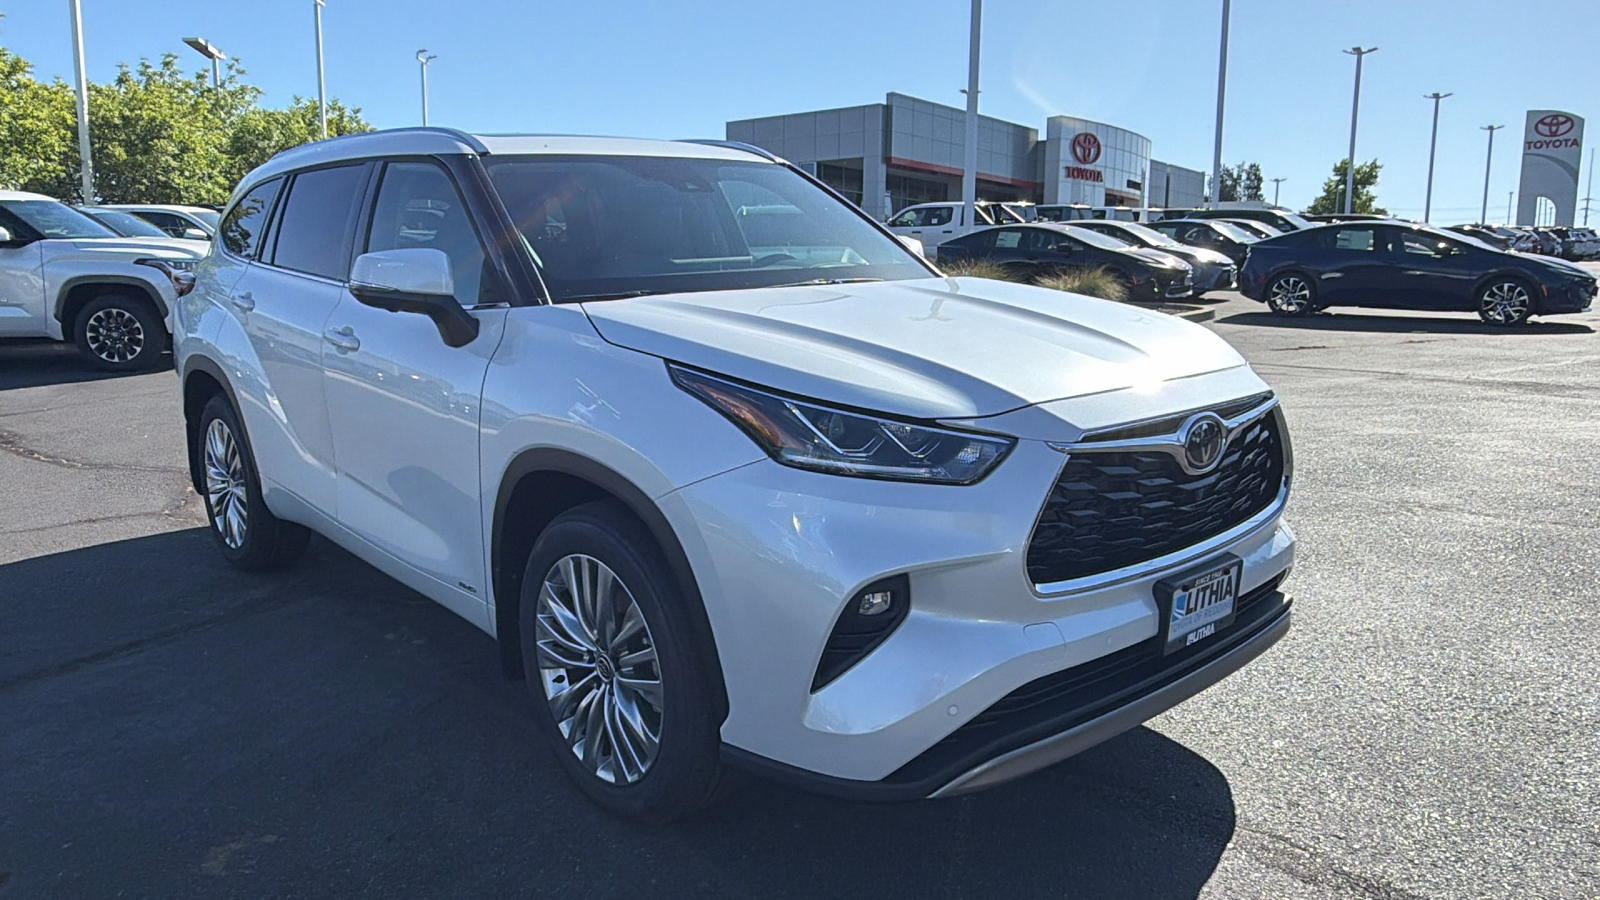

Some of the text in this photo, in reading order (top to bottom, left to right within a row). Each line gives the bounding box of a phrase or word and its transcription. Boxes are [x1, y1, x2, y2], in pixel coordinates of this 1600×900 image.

[1526, 138, 1579, 150] TOYOTA
[1065, 166, 1103, 183] TOYOTA
[1185, 575, 1233, 616] LITHIA
[1171, 598, 1232, 633] TOYOTA OF REDDING
[1194, 623, 1215, 642] LITHIA
